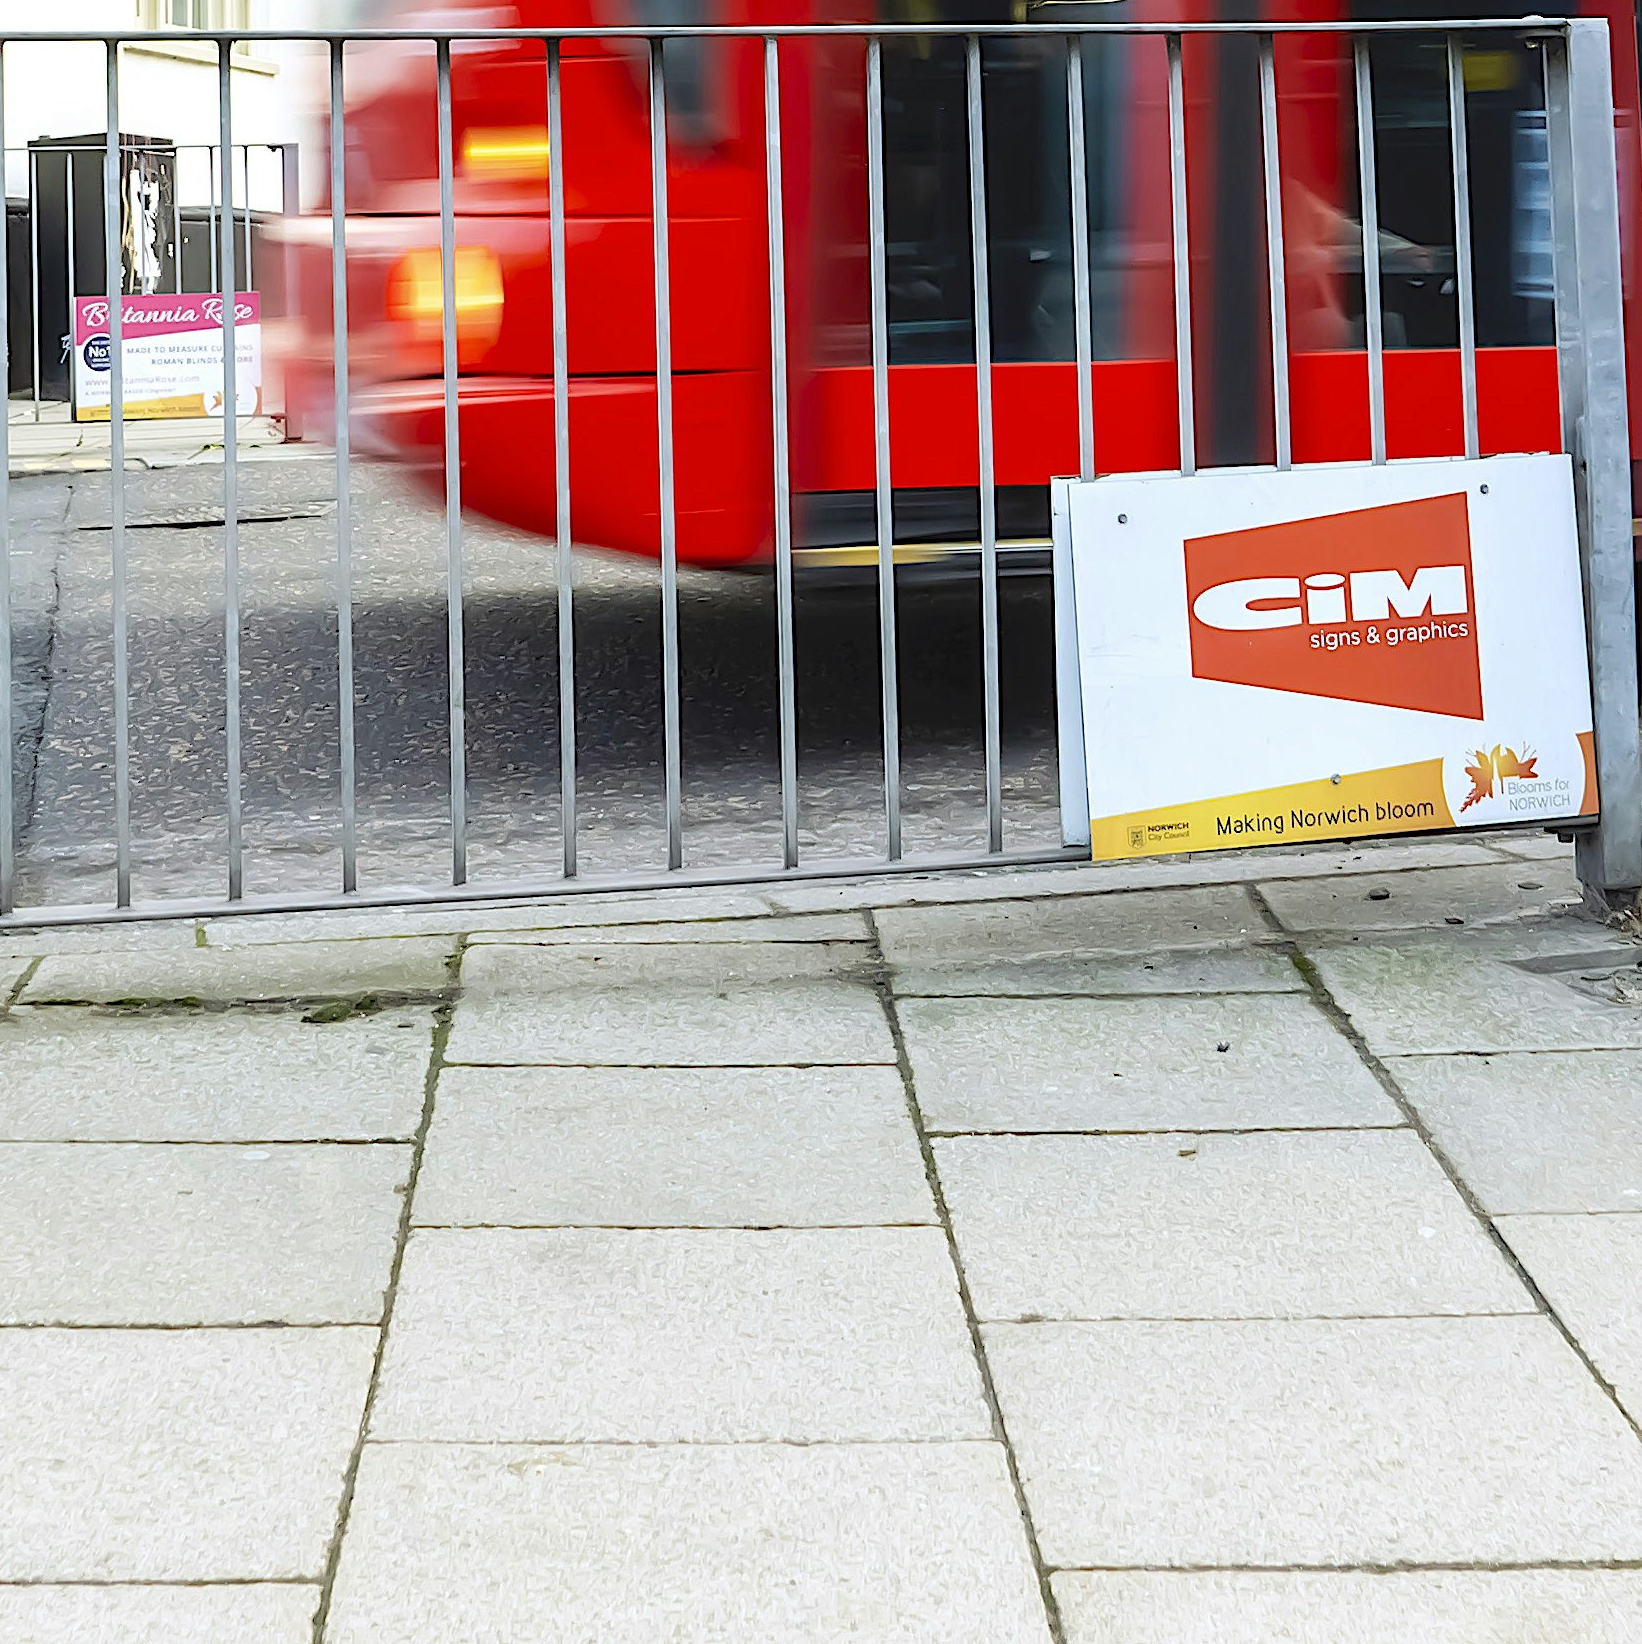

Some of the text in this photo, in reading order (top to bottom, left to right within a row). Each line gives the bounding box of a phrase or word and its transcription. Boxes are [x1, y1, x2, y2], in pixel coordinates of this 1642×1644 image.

[201, 297, 254, 325] Rse
[168, 344, 208, 353] MEASURE
[1310, 619, 1469, 651] signs & graphics
[1507, 778, 1570, 796] Blooms for
[1508, 794, 1571, 812] NORWICH
[1216, 800, 1435, 835] Making Norwich bloom
[1147, 822, 1190, 833] NORWICH
[1147, 830, 1190, 842] City Council
